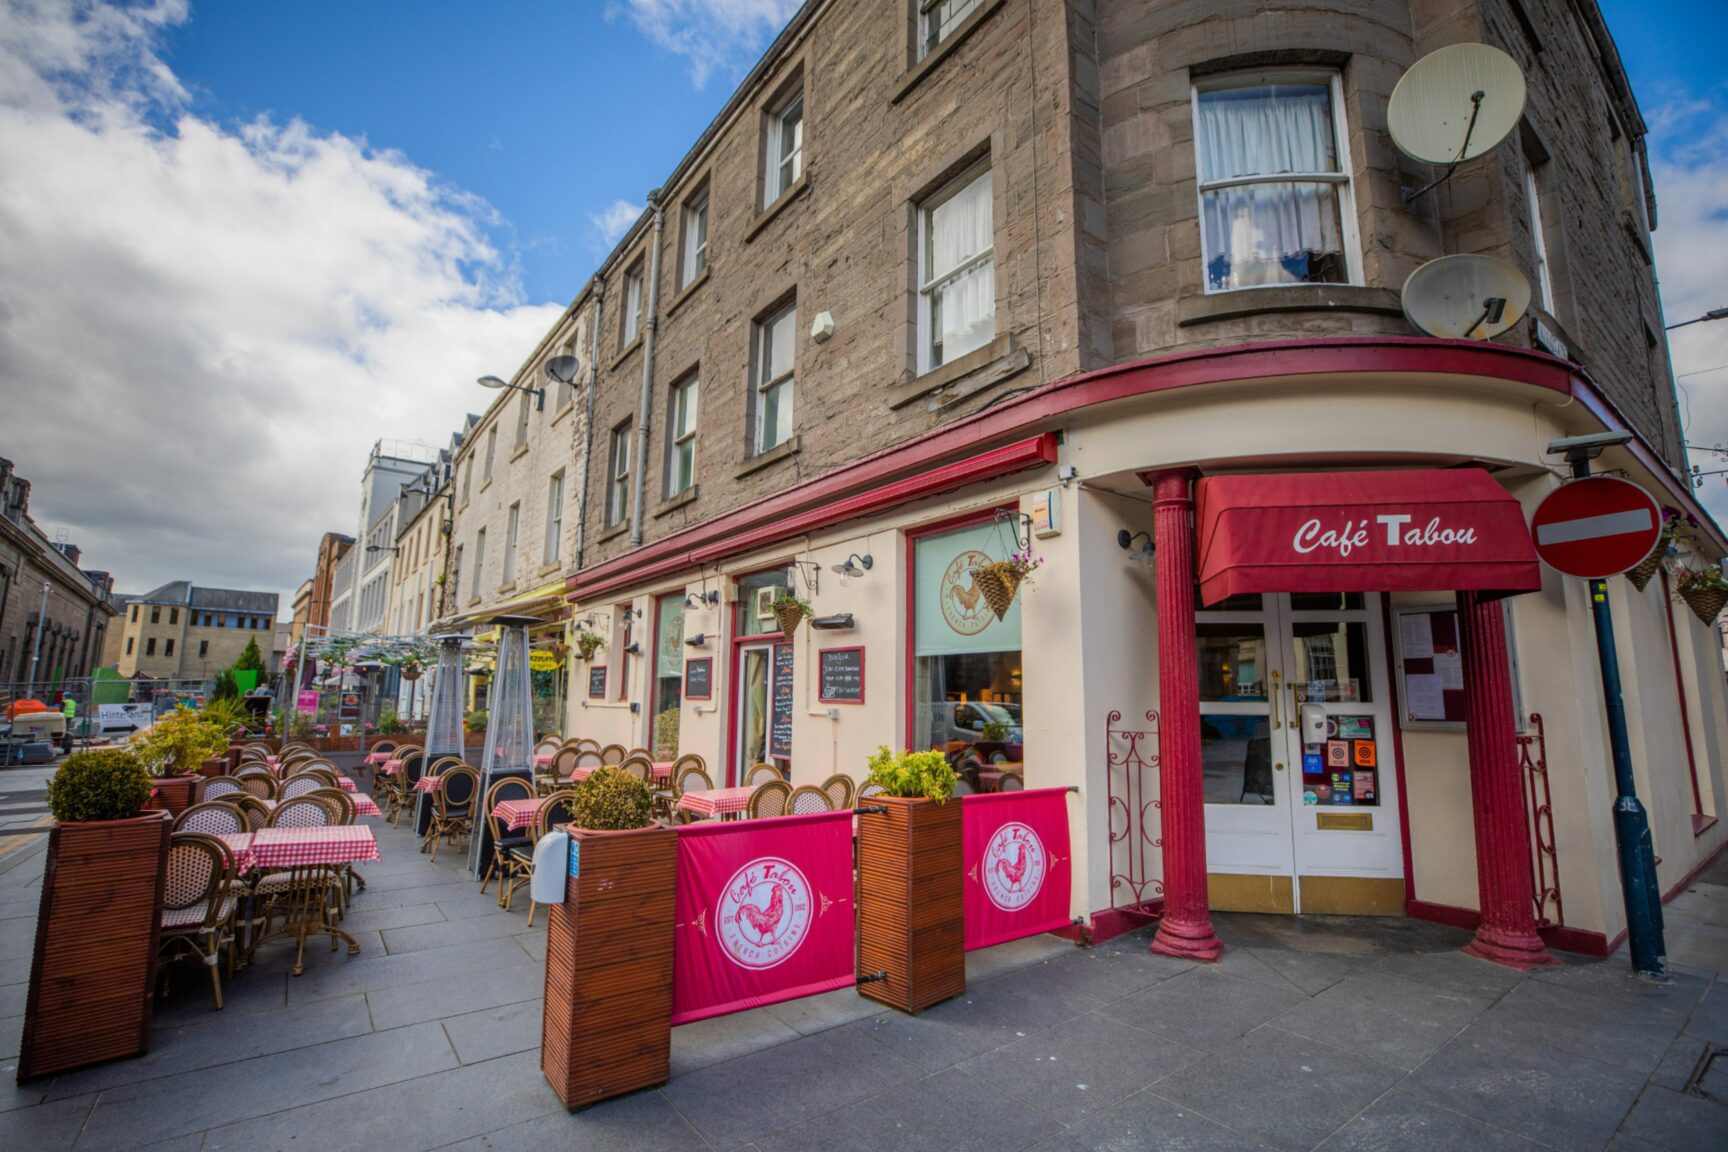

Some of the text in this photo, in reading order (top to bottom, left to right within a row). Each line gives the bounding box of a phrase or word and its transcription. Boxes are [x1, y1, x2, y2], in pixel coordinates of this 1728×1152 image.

[1293, 514, 1478, 557] Café Tabou
[991, 828, 1035, 858] Café Tabou
[730, 864, 797, 904] Café Tabou
